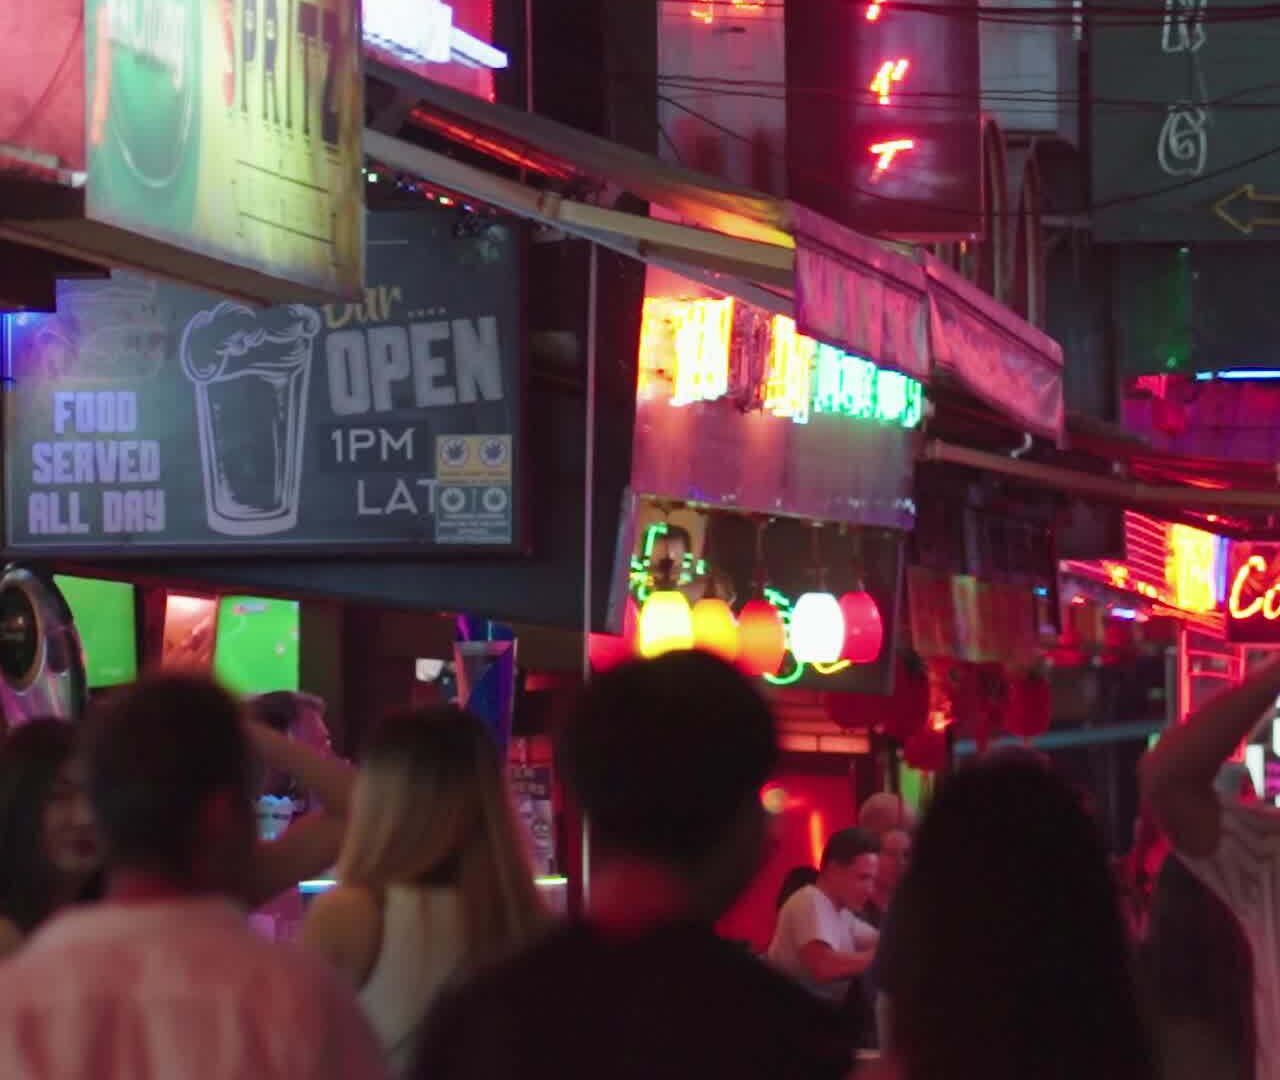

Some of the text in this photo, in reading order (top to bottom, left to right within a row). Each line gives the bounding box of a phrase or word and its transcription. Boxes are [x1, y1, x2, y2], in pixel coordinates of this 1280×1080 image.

[325, 315, 504, 416] OPEN
[53, 391, 138, 434] FOOD
[31, 440, 161, 485] SERVED
[330, 427, 416, 463] 1PM
[28, 487, 166, 535] ALL DAY
[357, 478, 438, 516] LAT
